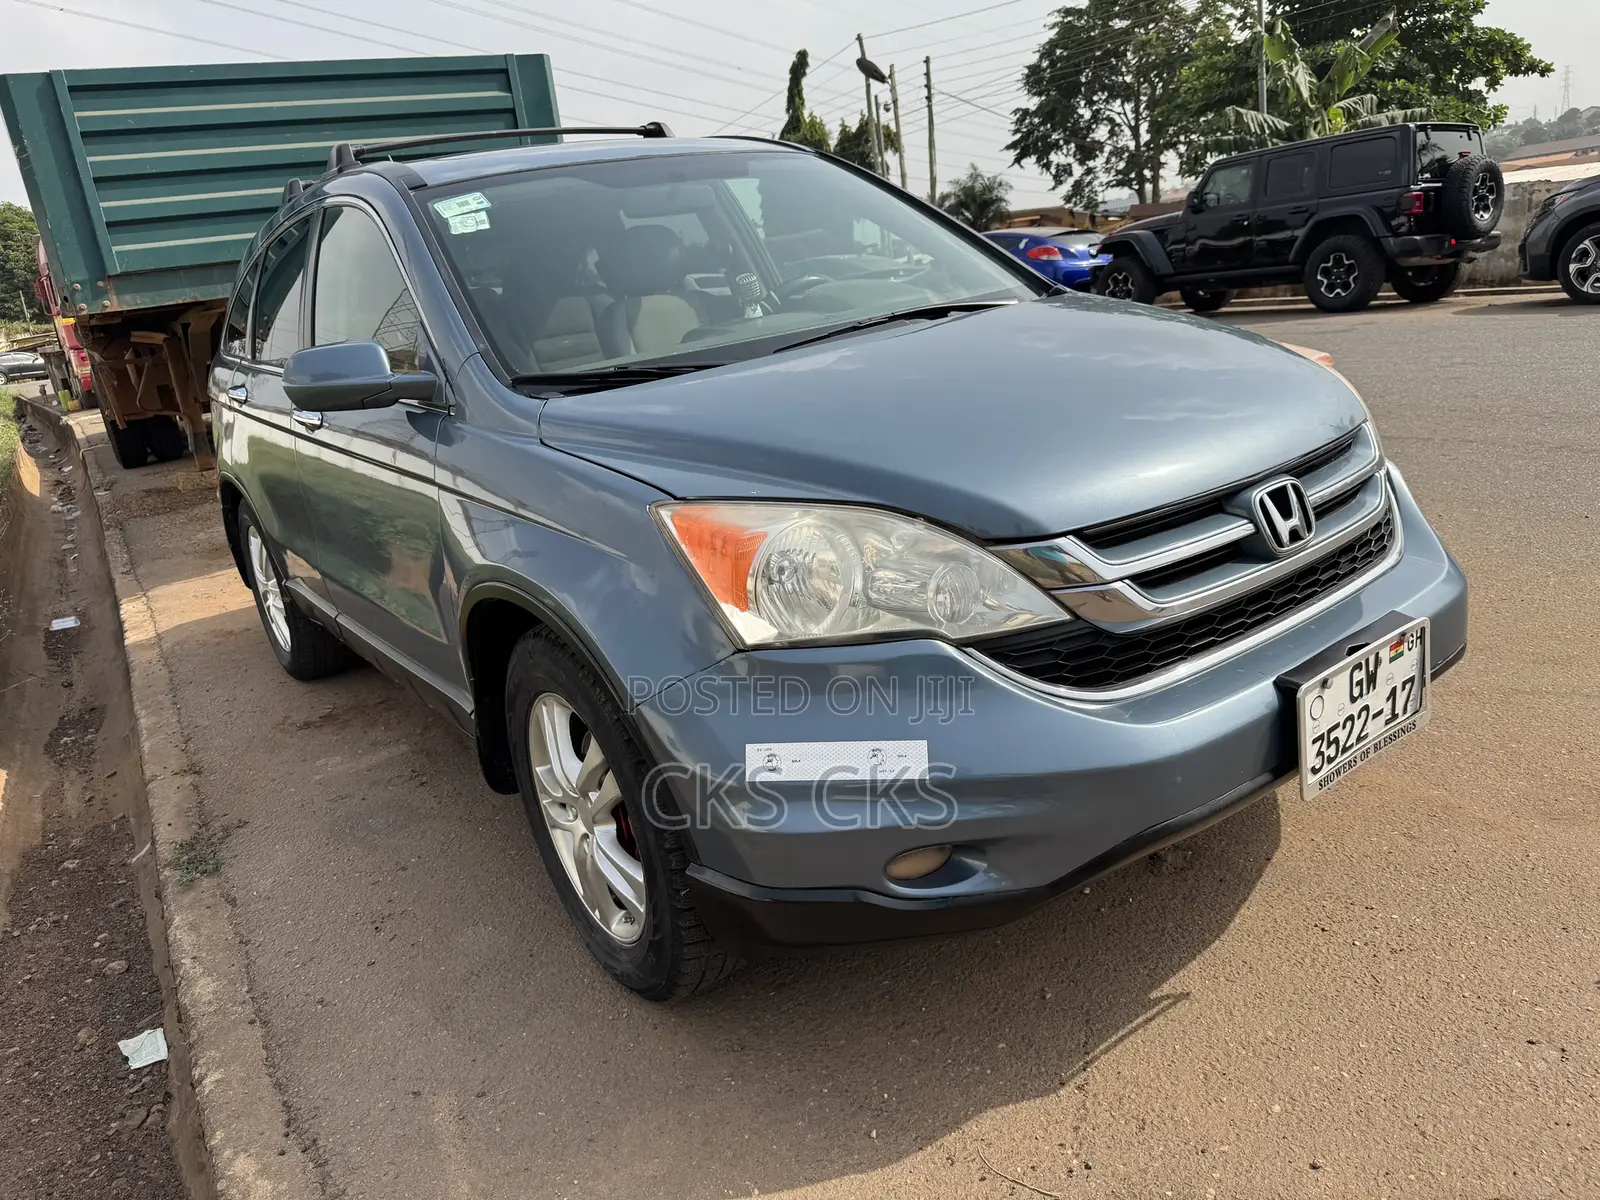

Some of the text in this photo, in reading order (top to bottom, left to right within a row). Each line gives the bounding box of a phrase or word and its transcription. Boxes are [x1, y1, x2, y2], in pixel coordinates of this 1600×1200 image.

[1407, 629, 1423, 651] GH
[1350, 652, 1379, 704] GW
[1311, 675, 1415, 775] 3522-17
[1318, 721, 1417, 791] SHOWERS OF BLESSINGS
